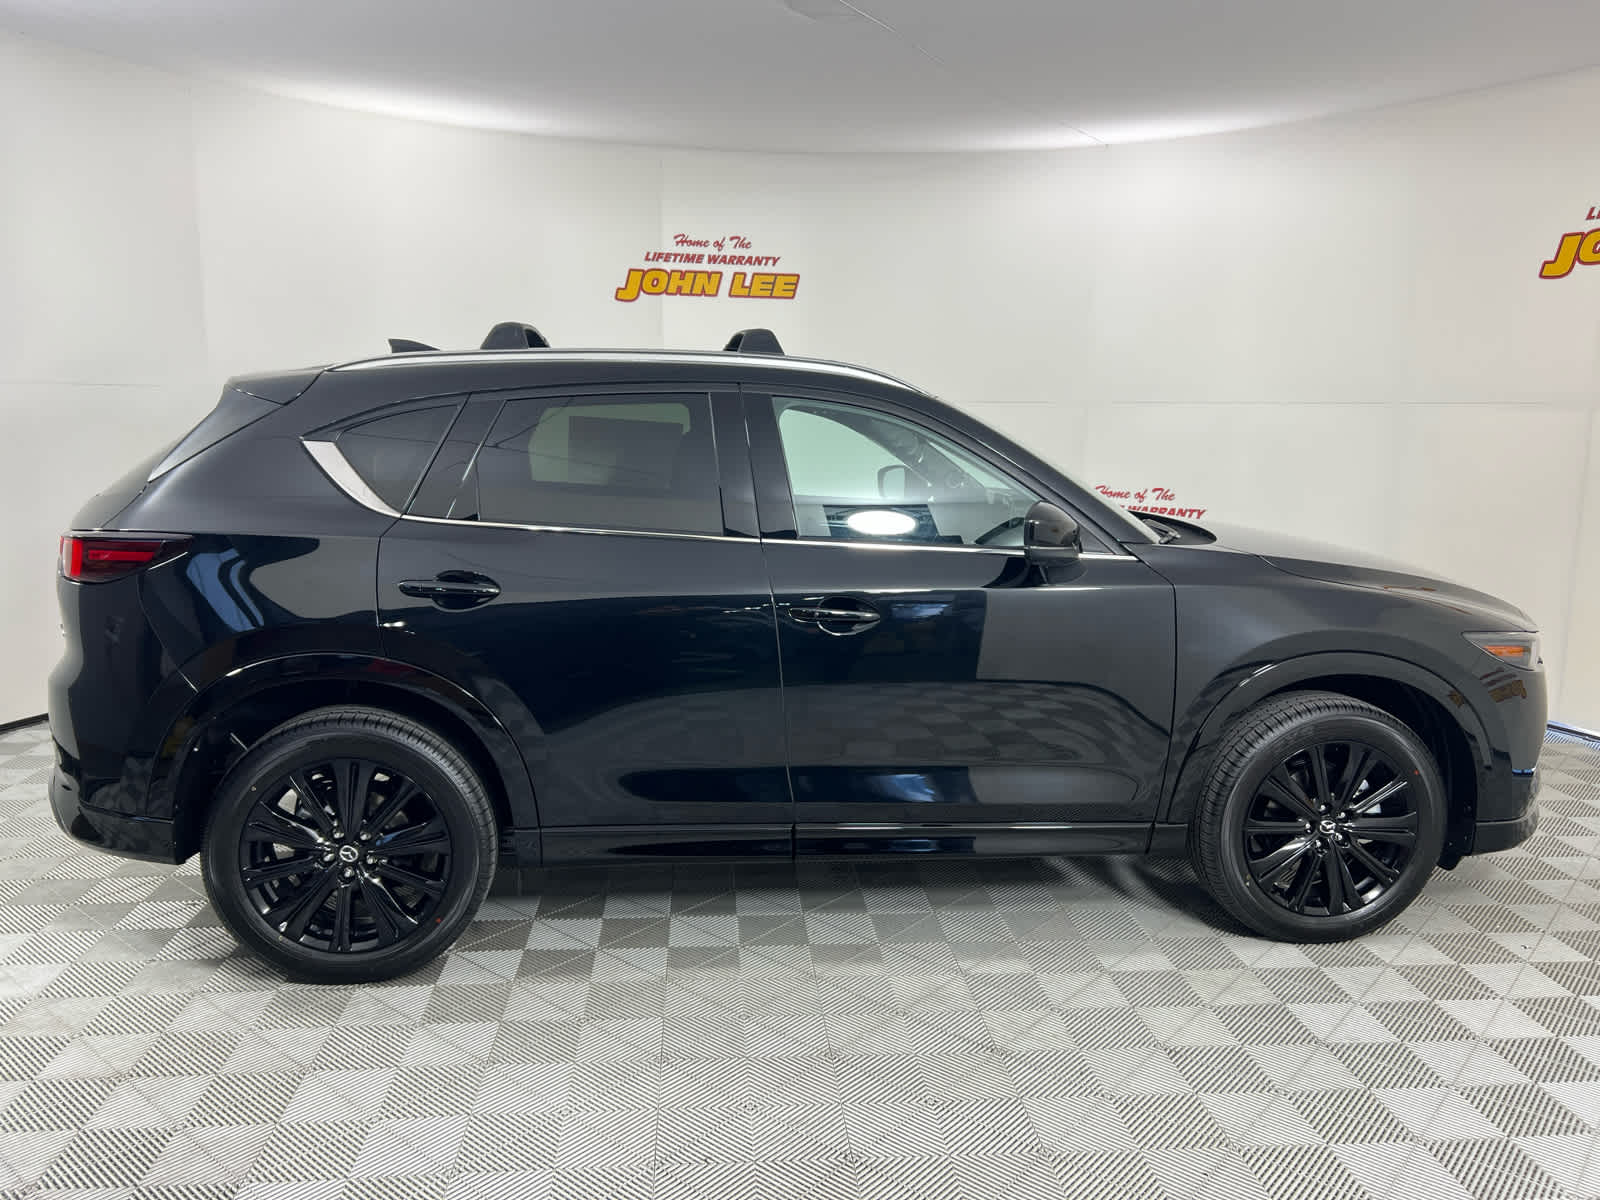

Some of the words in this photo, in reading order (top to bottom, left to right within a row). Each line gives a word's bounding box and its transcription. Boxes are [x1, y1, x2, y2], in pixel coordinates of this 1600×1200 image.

[673, 233, 710, 248] Home
[712, 237, 725, 252] of
[729, 235, 752, 249] The
[644, 251, 705, 265] LIFETIME
[707, 253, 780, 267] WARRANTY
[615, 268, 723, 302] JOHN
[728, 271, 801, 300] LEE
[1134, 488, 1148, 504] of
[1151, 487, 1176, 502] The
